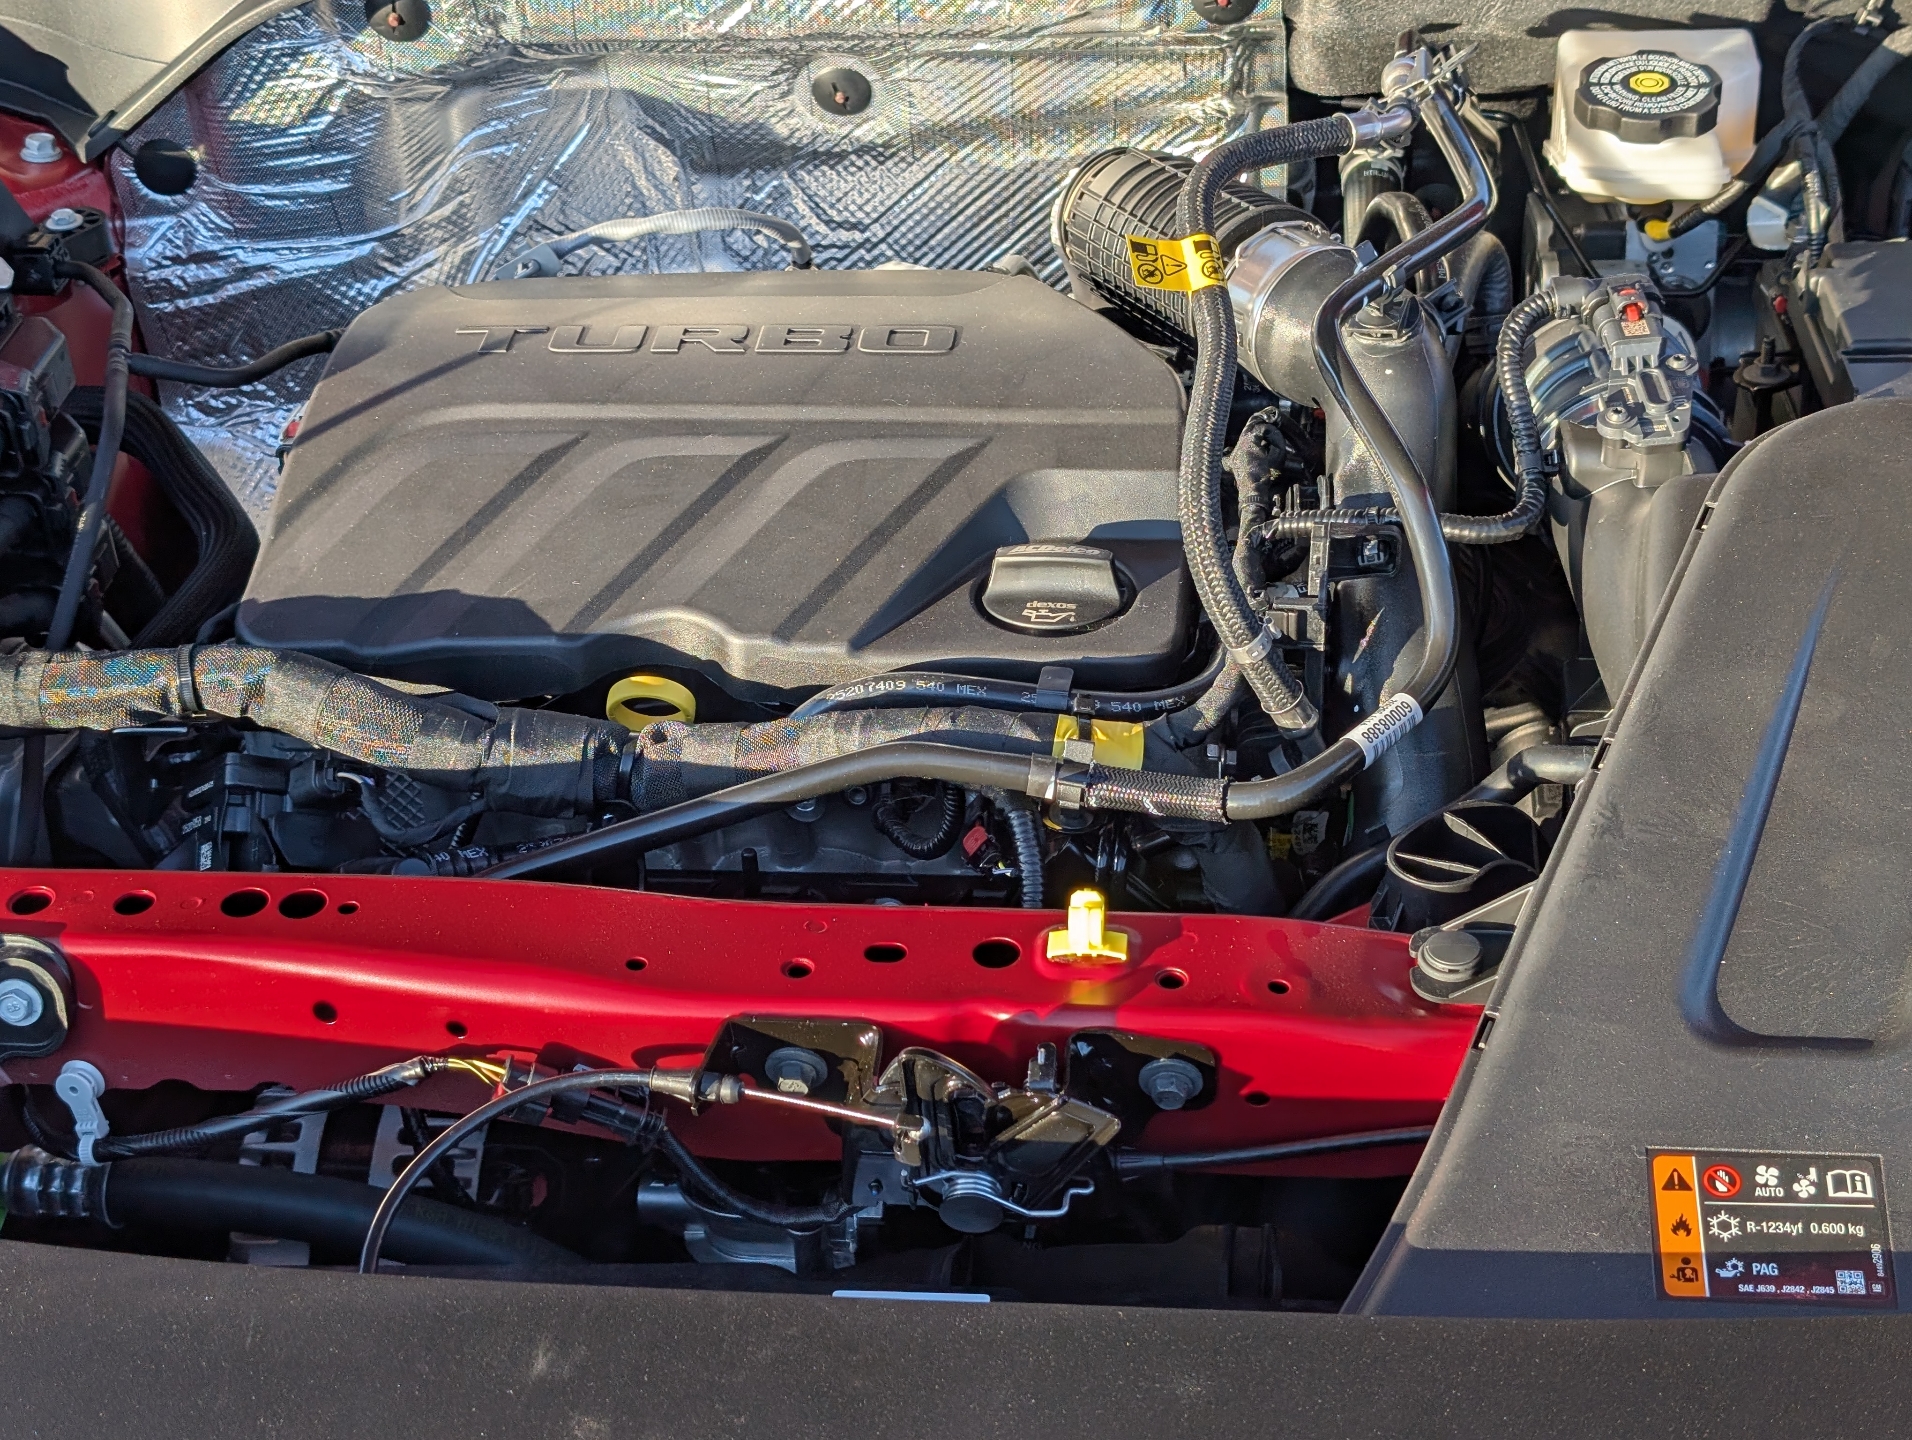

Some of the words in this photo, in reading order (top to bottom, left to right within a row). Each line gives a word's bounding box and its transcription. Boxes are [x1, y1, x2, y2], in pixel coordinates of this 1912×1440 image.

[1618, 104, 1643, 113] FROM
[1650, 104, 1681, 114] SEALED
[456, 324, 958, 354] TURBO
[1007, 545, 1101, 555] ACDelco
[1026, 601, 1077, 609] dexos
[916, 681, 945, 692] 540
[957, 684, 987, 695] MEX
[1111, 701, 1142, 713] 540
[1154, 696, 1187, 710] MEX
[1361, 701, 1413, 744] 60008388
[457, 847, 489, 859] MEX
[1755, 1187, 1784, 1198] AUTO
[1746, 1221, 1803, 1236] R-1234yf
[1810, 1223, 1845, 1235] 0.600
[1848, 1223, 1864, 1237] kg
[1752, 1262, 1779, 1276] PAG
[1738, 1284, 1754, 1293] SAE
